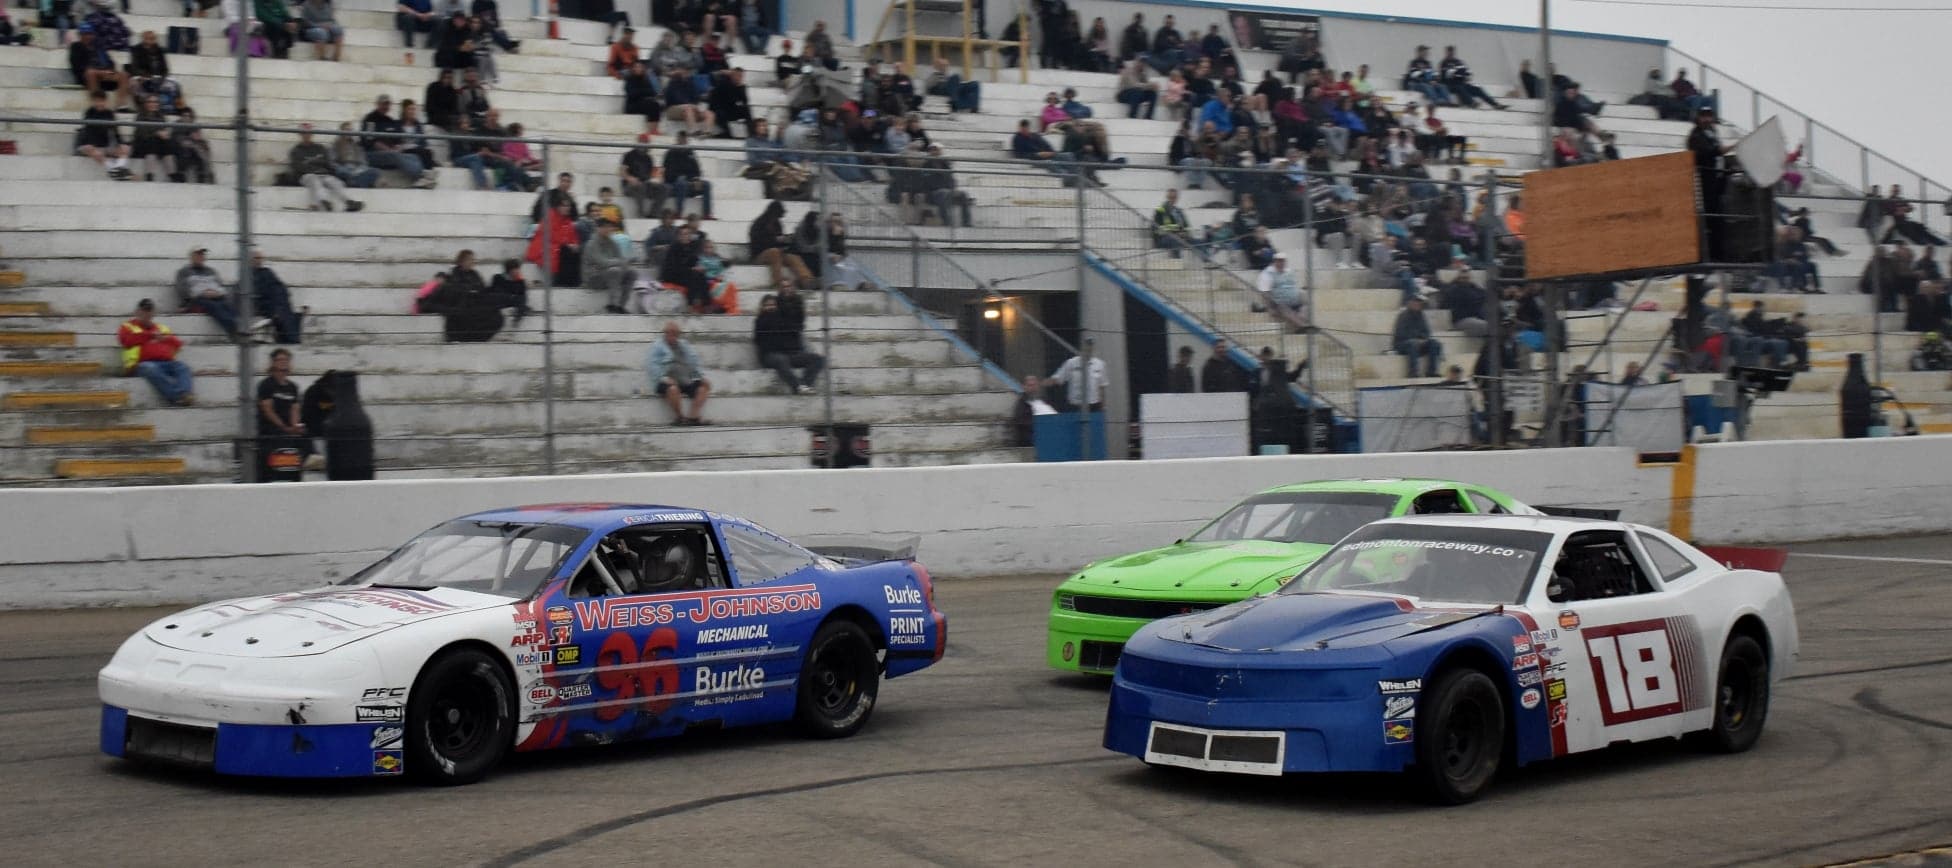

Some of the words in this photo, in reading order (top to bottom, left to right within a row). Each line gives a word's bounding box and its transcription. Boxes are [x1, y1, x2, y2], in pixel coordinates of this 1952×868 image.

[1341, 538, 1525, 560] edmontonraceway.co
[884, 585, 921, 604] Burke
[890, 618, 925, 634] PRINT
[511, 632, 545, 647] ARP
[696, 624, 769, 644] MECHANICAL
[890, 635, 925, 645] SPECIALISTS
[516, 651, 540, 665] Mobil
[557, 650, 579, 661] OMP
[1513, 654, 1538, 668] ARP
[595, 627, 679, 721] 96
[1588, 629, 1680, 714] 18
[695, 663, 765, 695] Burke
[1378, 678, 1422, 691] WHELEN
[362, 687, 406, 697] PFC
[531, 689, 553, 700] BELL
[357, 707, 401, 718] WHELEN
